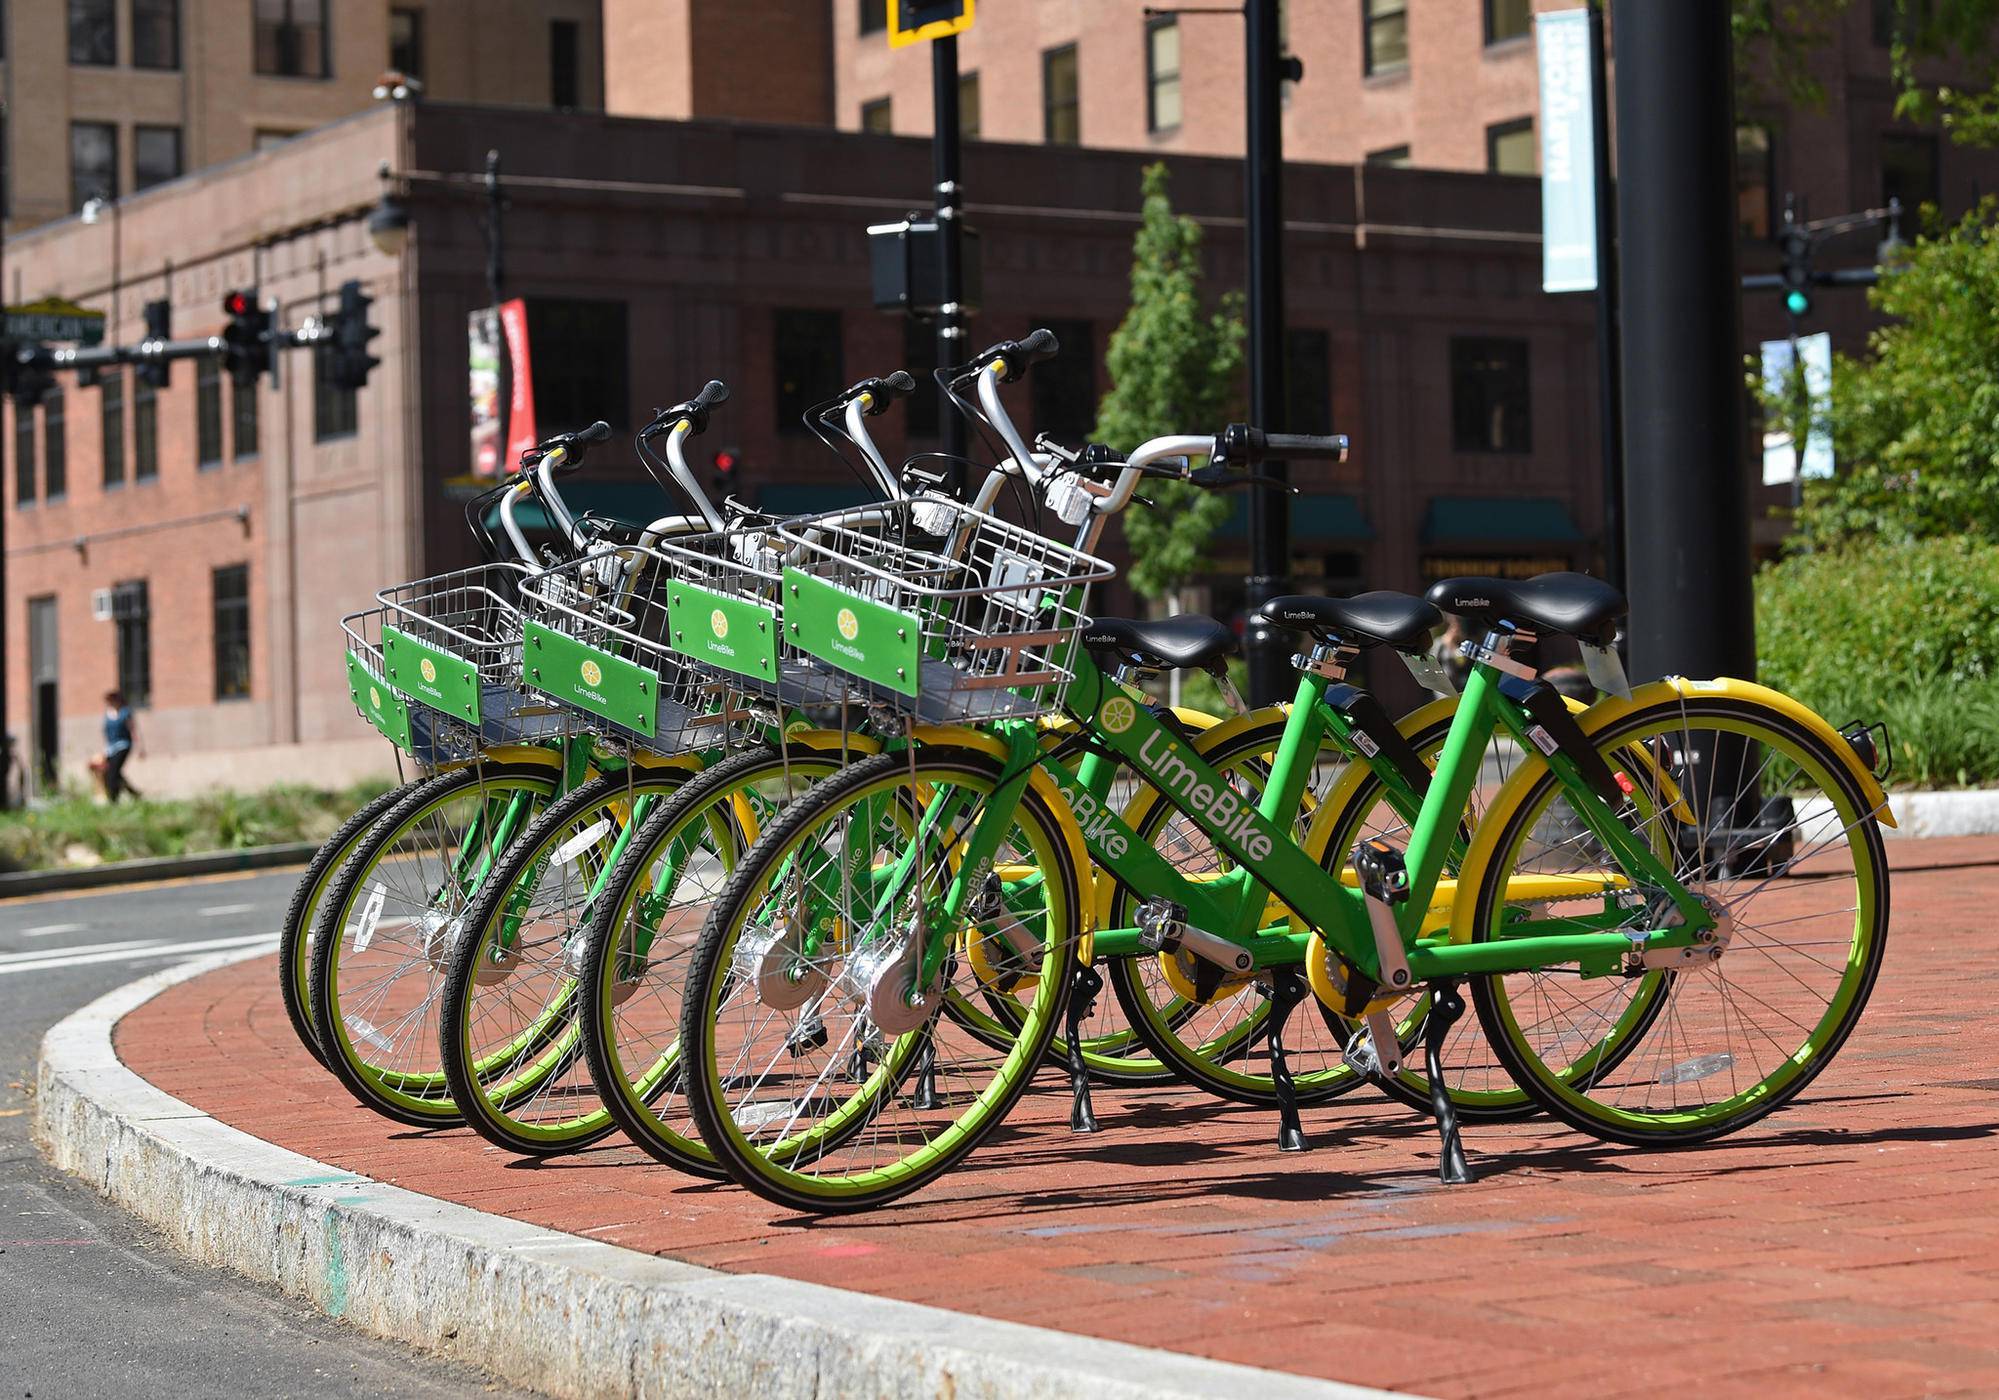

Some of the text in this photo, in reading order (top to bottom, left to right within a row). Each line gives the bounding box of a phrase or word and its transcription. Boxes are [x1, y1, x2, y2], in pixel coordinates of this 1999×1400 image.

[1454, 597, 1490, 607] LimeBike
[1283, 611, 1316, 620] LimeBike
[707, 639, 735, 656] LimeBike
[1085, 634, 1117, 643] LimeBike
[831, 638, 865, 662] LimeBike
[417, 681, 443, 699] LimeBike
[574, 683, 607, 705] LimeBike
[1139, 728, 1273, 862] LimeBike
[523, 846, 555, 901] LimeBike
